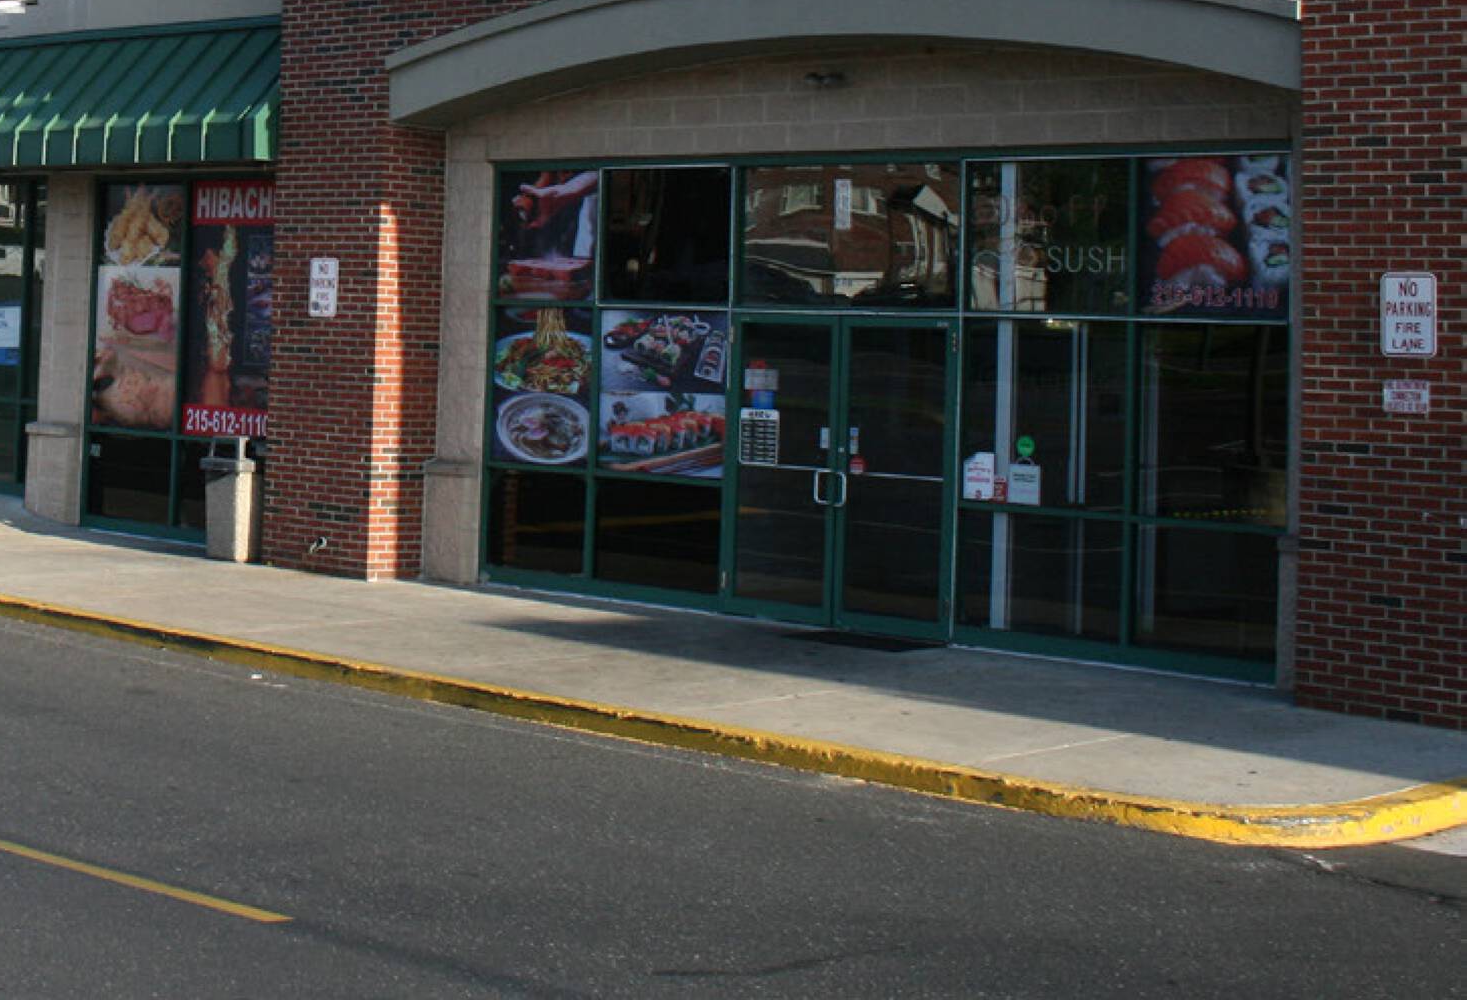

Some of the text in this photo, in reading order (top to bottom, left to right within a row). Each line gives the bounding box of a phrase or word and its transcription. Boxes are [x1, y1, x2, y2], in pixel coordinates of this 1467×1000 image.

[196, 187, 275, 218] HIBACH
[1047, 245, 1126, 273] SUSH
[1397, 281, 1418, 297] NO
[1385, 301, 1432, 317] PARKING
[1395, 322, 1422, 334] FIRE
[1391, 338, 1426, 350] LANE
